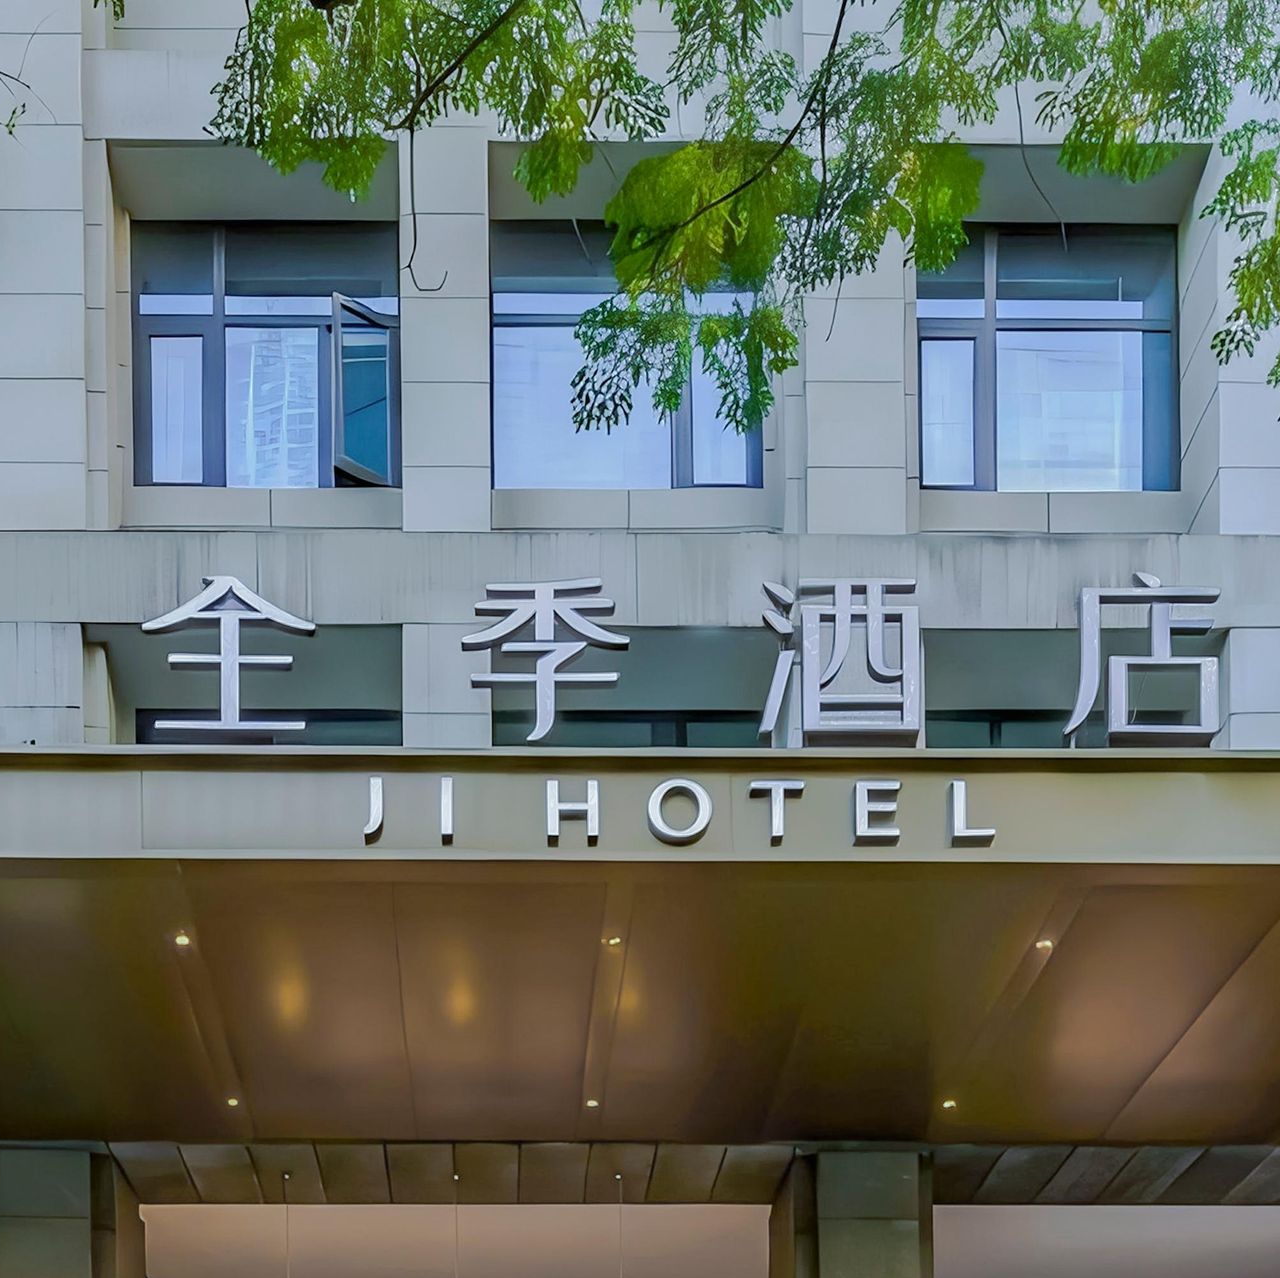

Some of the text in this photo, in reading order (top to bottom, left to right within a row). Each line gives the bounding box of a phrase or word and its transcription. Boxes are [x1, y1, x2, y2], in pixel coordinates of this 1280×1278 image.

[140, 573, 1222, 747] 全季酒店
[363, 775, 997, 846] JI HOTEL
